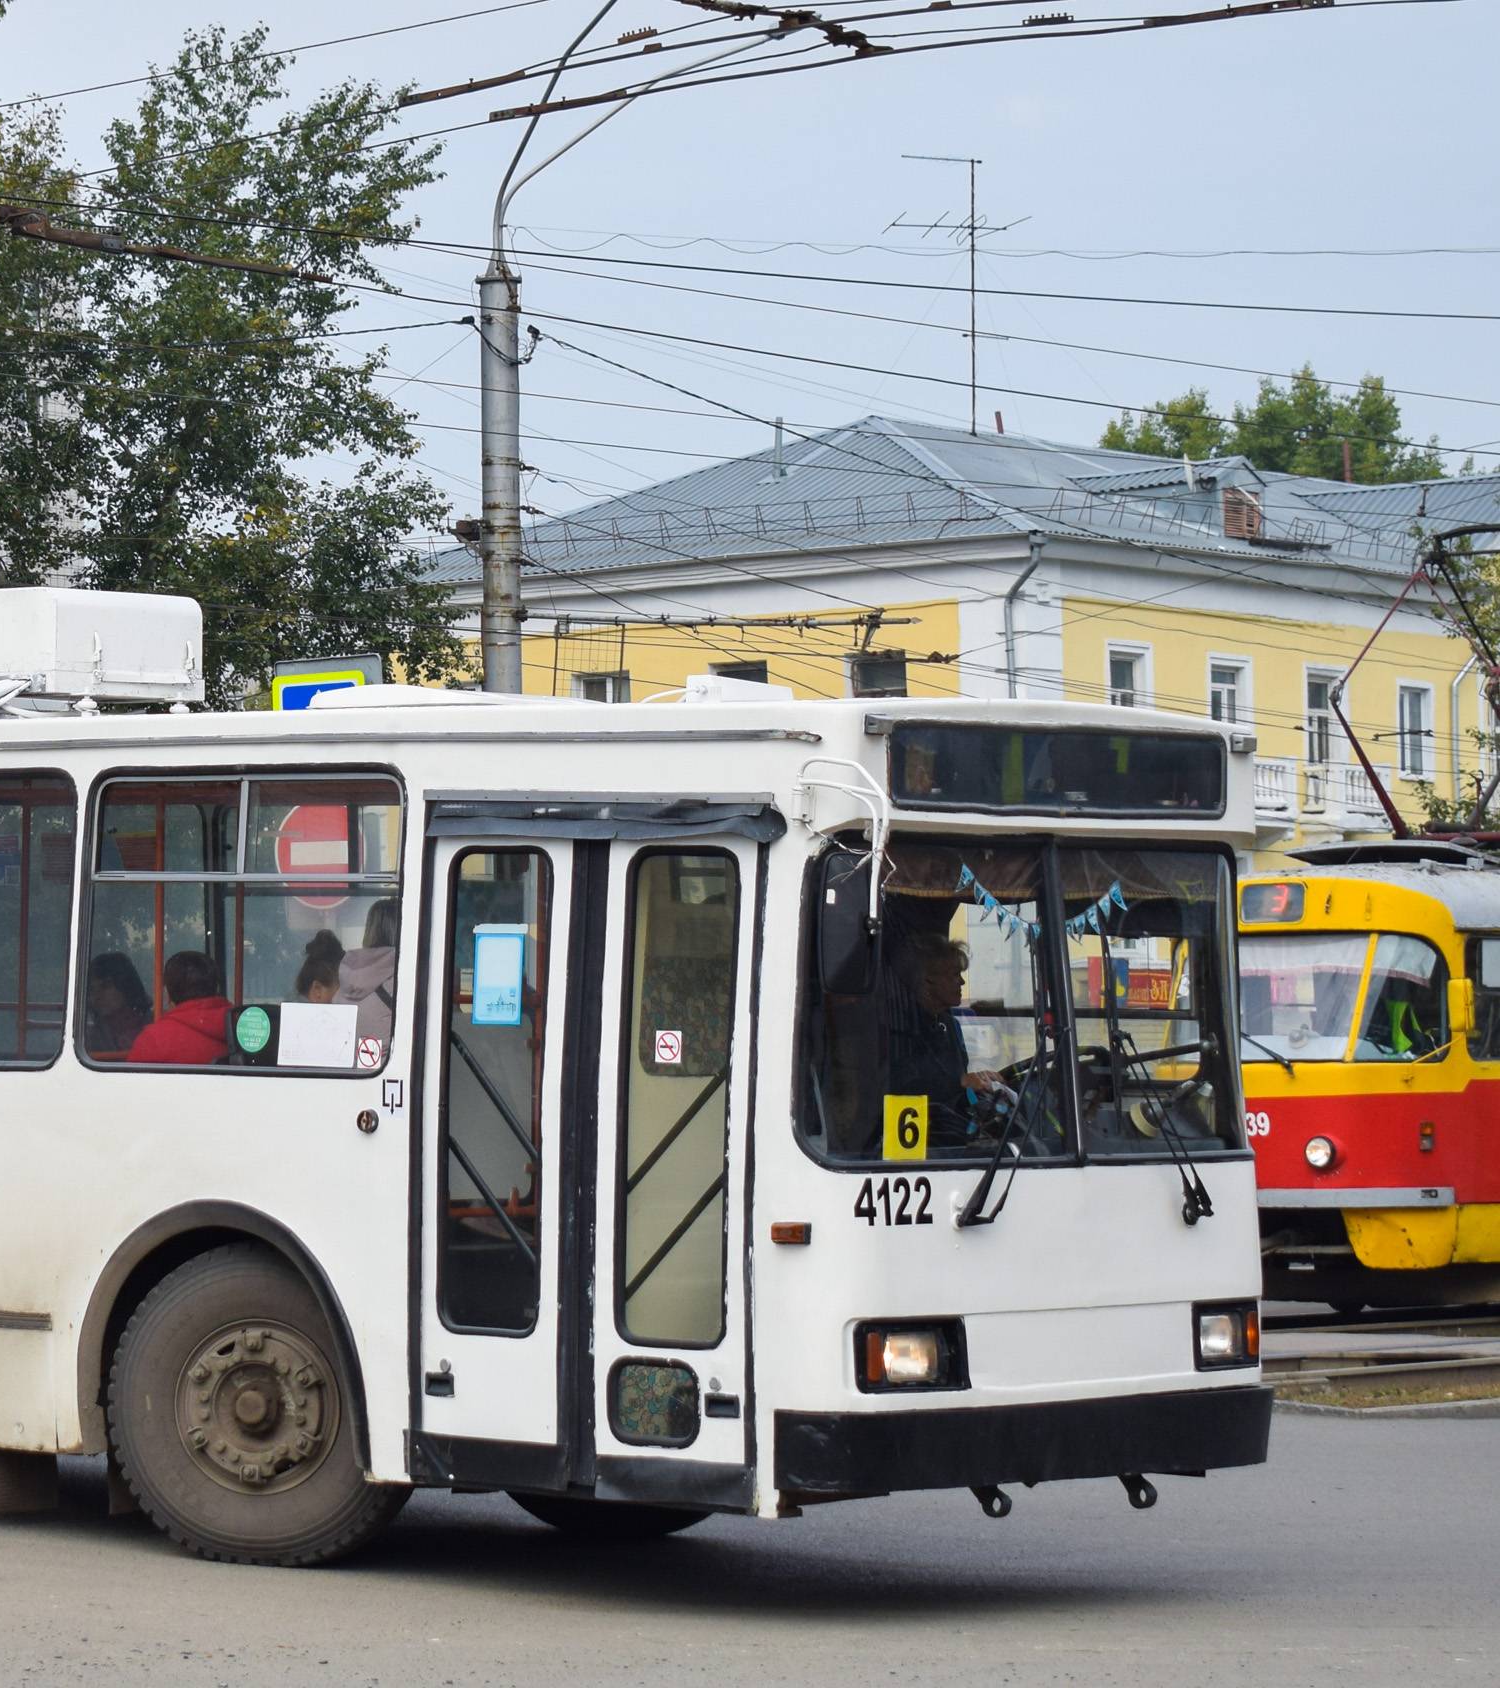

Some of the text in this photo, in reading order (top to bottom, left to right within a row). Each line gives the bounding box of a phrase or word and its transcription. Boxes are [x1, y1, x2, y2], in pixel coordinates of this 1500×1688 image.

[1270, 883, 1289, 913] 3
[897, 1107, 919, 1149] 6
[1245, 1111, 1270, 1137] 39
[854, 1176, 933, 1226] 4122
